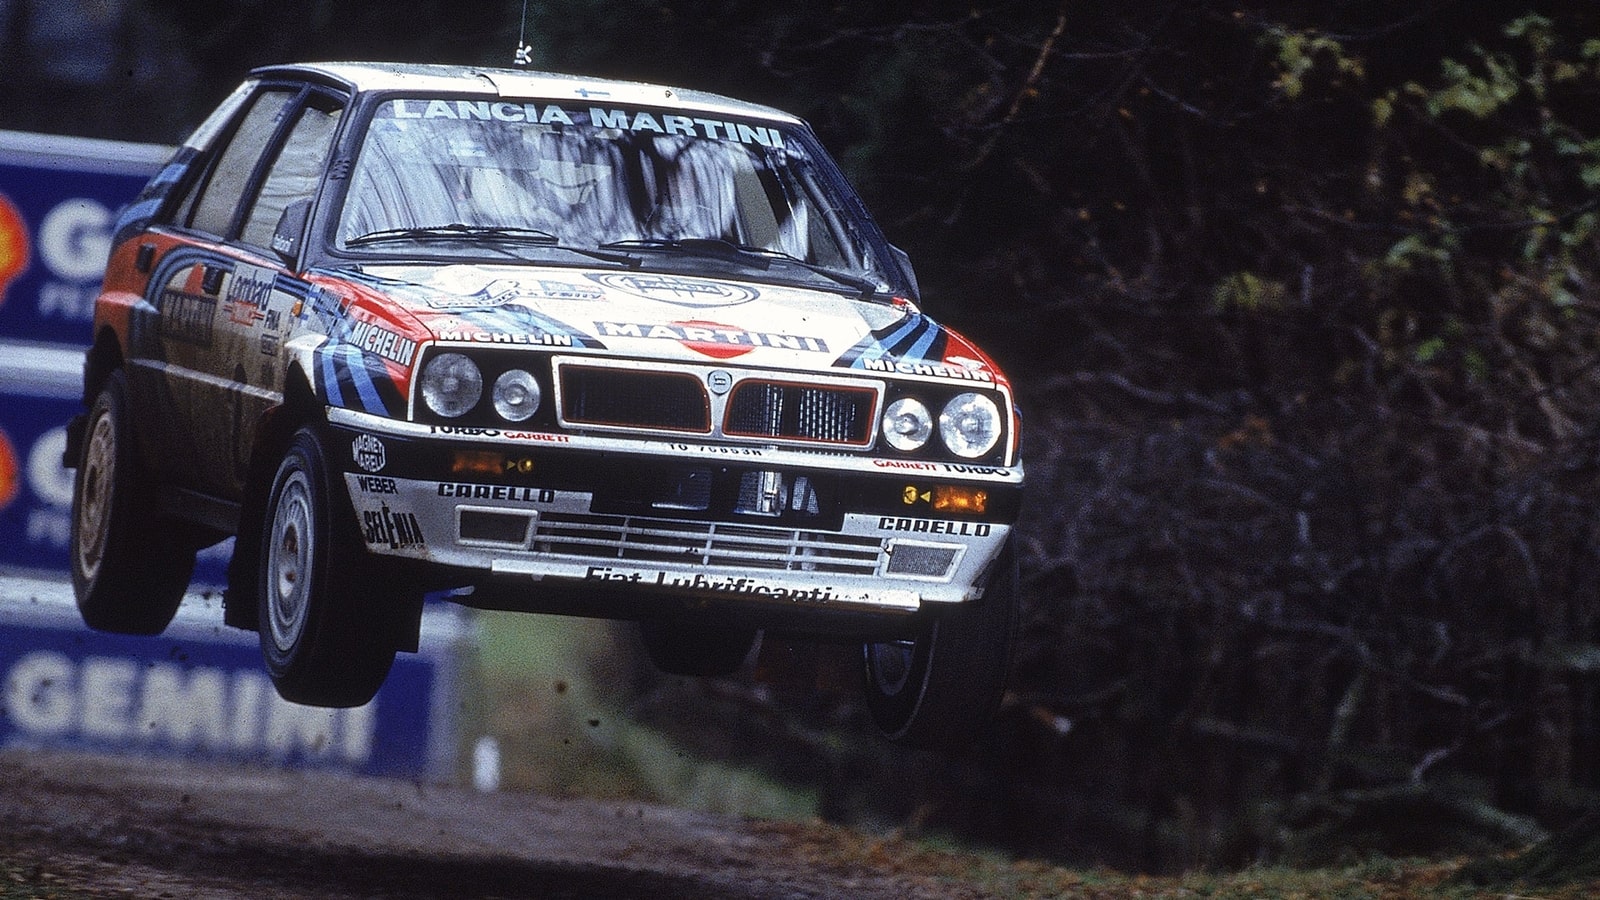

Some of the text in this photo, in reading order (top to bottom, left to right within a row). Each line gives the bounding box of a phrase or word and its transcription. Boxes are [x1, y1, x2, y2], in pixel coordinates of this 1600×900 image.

[392, 98, 785, 149] LANCIA MARTINI
[348, 319, 418, 368] MICHELIN
[438, 330, 573, 347] MICHELIN
[600, 321, 826, 353] MARTINI
[862, 357, 993, 382] MICHELIN
[430, 425, 570, 443] TURBO GARRETT
[872, 459, 1011, 477] GARRETT TURBO
[356, 476, 399, 495] WEBER
[437, 483, 555, 504] CARELLO
[878, 517, 991, 537] CARELLO
[585, 566, 643, 583] Fiat
[7, 651, 374, 762] GEMINI
